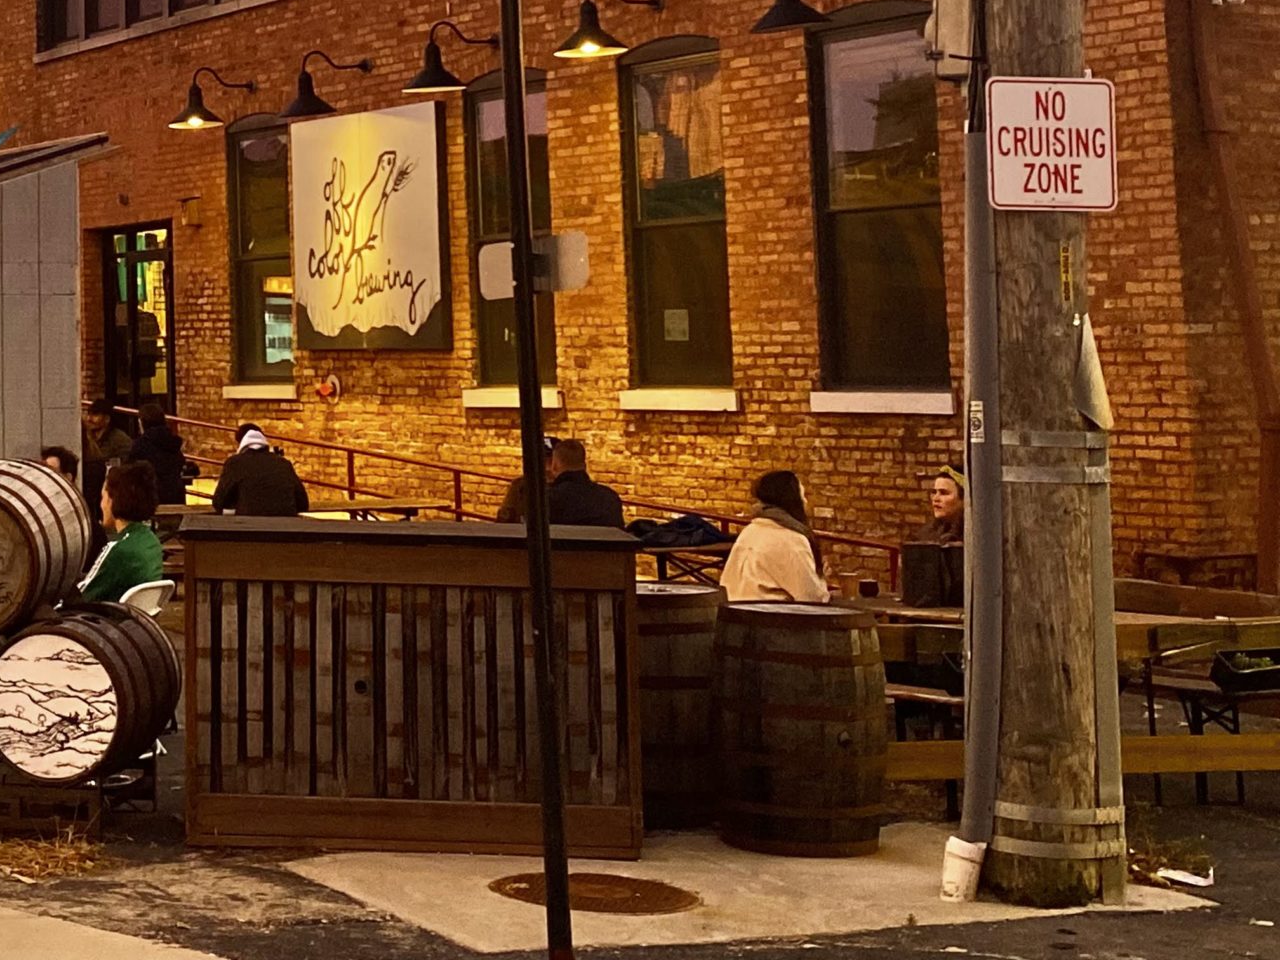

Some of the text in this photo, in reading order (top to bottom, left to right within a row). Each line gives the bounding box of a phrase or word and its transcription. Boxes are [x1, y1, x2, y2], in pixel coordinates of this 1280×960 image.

[1035, 91, 1065, 121] NO
[998, 126, 1106, 158] CRUISING
[1023, 163, 1083, 194] ZONE
[352, 251, 427, 325] brewing
